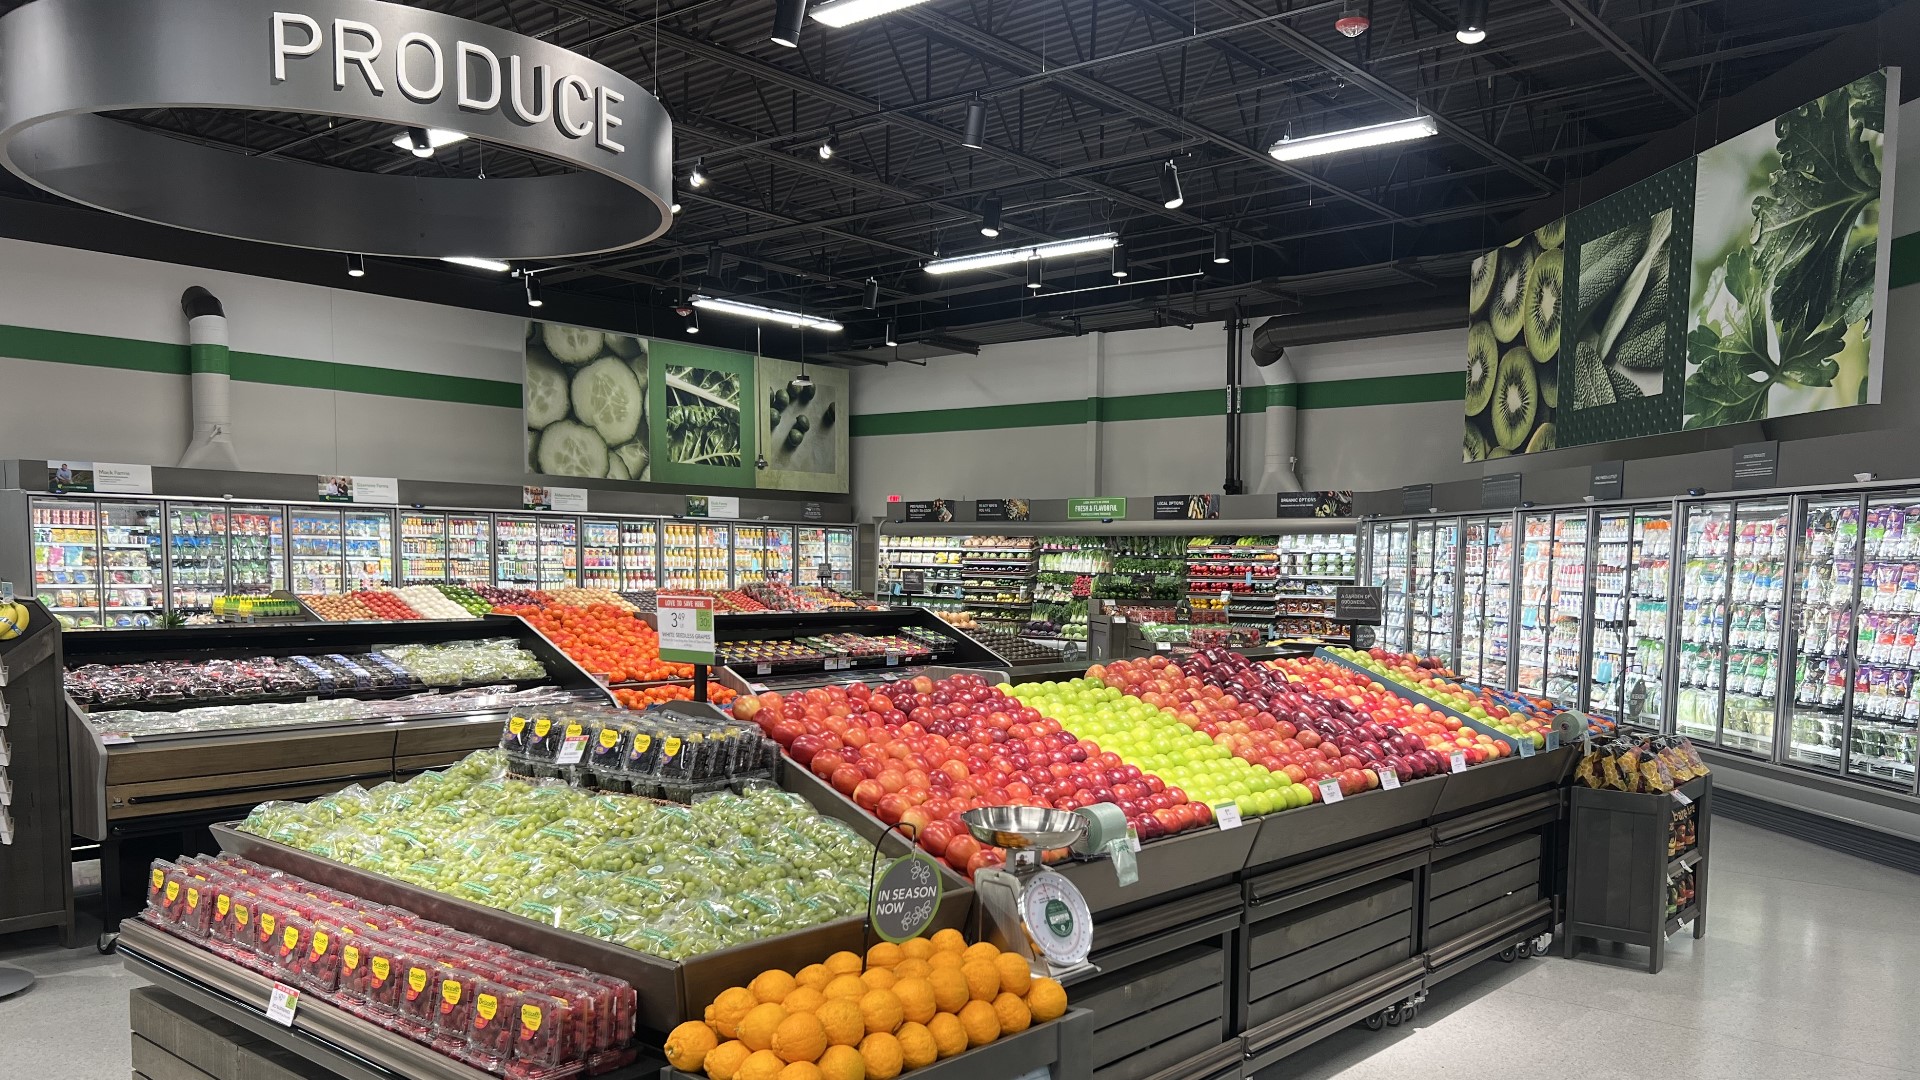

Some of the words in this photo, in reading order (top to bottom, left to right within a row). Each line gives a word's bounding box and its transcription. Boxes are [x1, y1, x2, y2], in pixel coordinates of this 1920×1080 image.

[273, 12, 625, 152] PRODUCE
[878, 890, 890, 902] IN
[892, 886, 937, 901] SEASON
[876, 901, 905, 916] NOW
